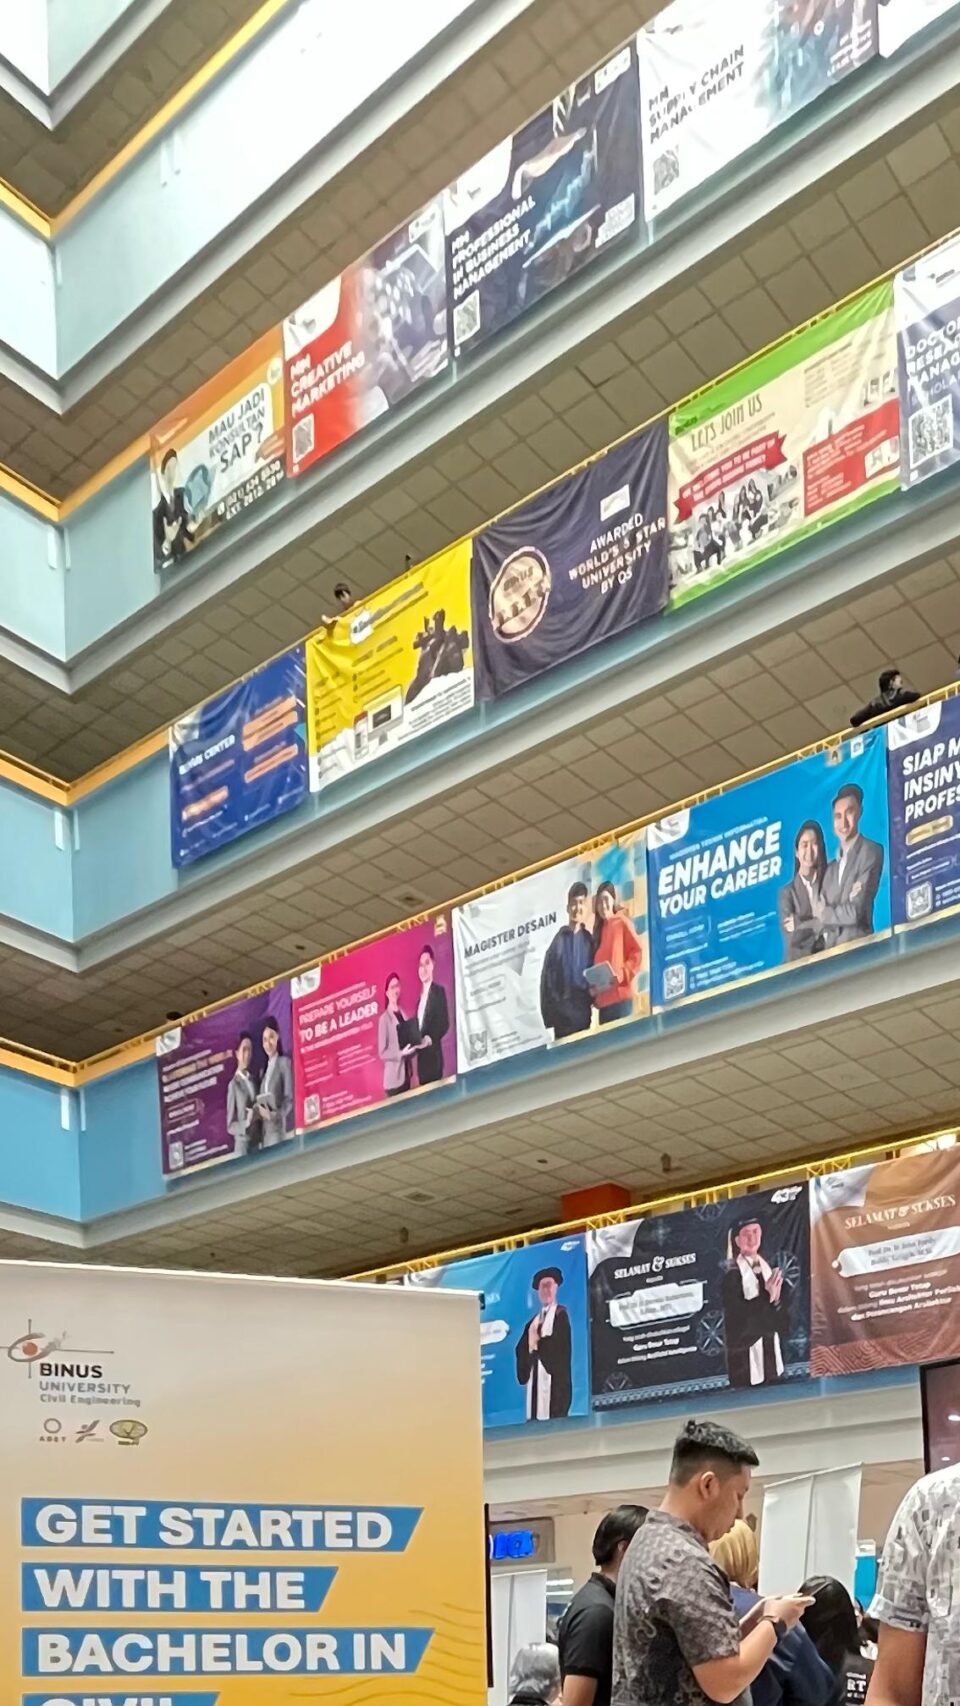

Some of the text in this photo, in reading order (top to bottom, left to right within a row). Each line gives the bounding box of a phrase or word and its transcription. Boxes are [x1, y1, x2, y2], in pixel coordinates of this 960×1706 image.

[701, 44, 744, 87] CHAIN
[649, 85, 669, 111] MM
[209, 388, 265, 443] MAU JADI
[748, 393, 762, 417] US
[590, 513, 643, 553] AWARDED
[636, 517, 665, 543] STAR
[582, 540, 651, 589] UNIVERSITY
[601, 575, 615, 594] BY
[903, 742, 946, 776] SIAP
[658, 821, 782, 896] ENHANCE
[659, 855, 782, 918] YOUR CAREER
[464, 911, 557, 958] MAGISTER DESAIN
[299, 1027, 313, 1043] TO
[314, 1020, 328, 1037] BE
[329, 1017, 338, 1032] A
[339, 1001, 378, 1028] LEADER
[845, 1206, 895, 1230] SELAMAT
[651, 1256, 665, 1272] &
[40, 1363, 103, 1378] BINUS
[40, 1381, 131, 1394] UNIVERSITY
[40, 1394, 141, 1408] Civil Engineering
[35, 1504, 392, 1548] GET STARTED
[35, 1568, 305, 1609] WITH THE
[37, 1632, 405, 1673] BACHELOR IN
